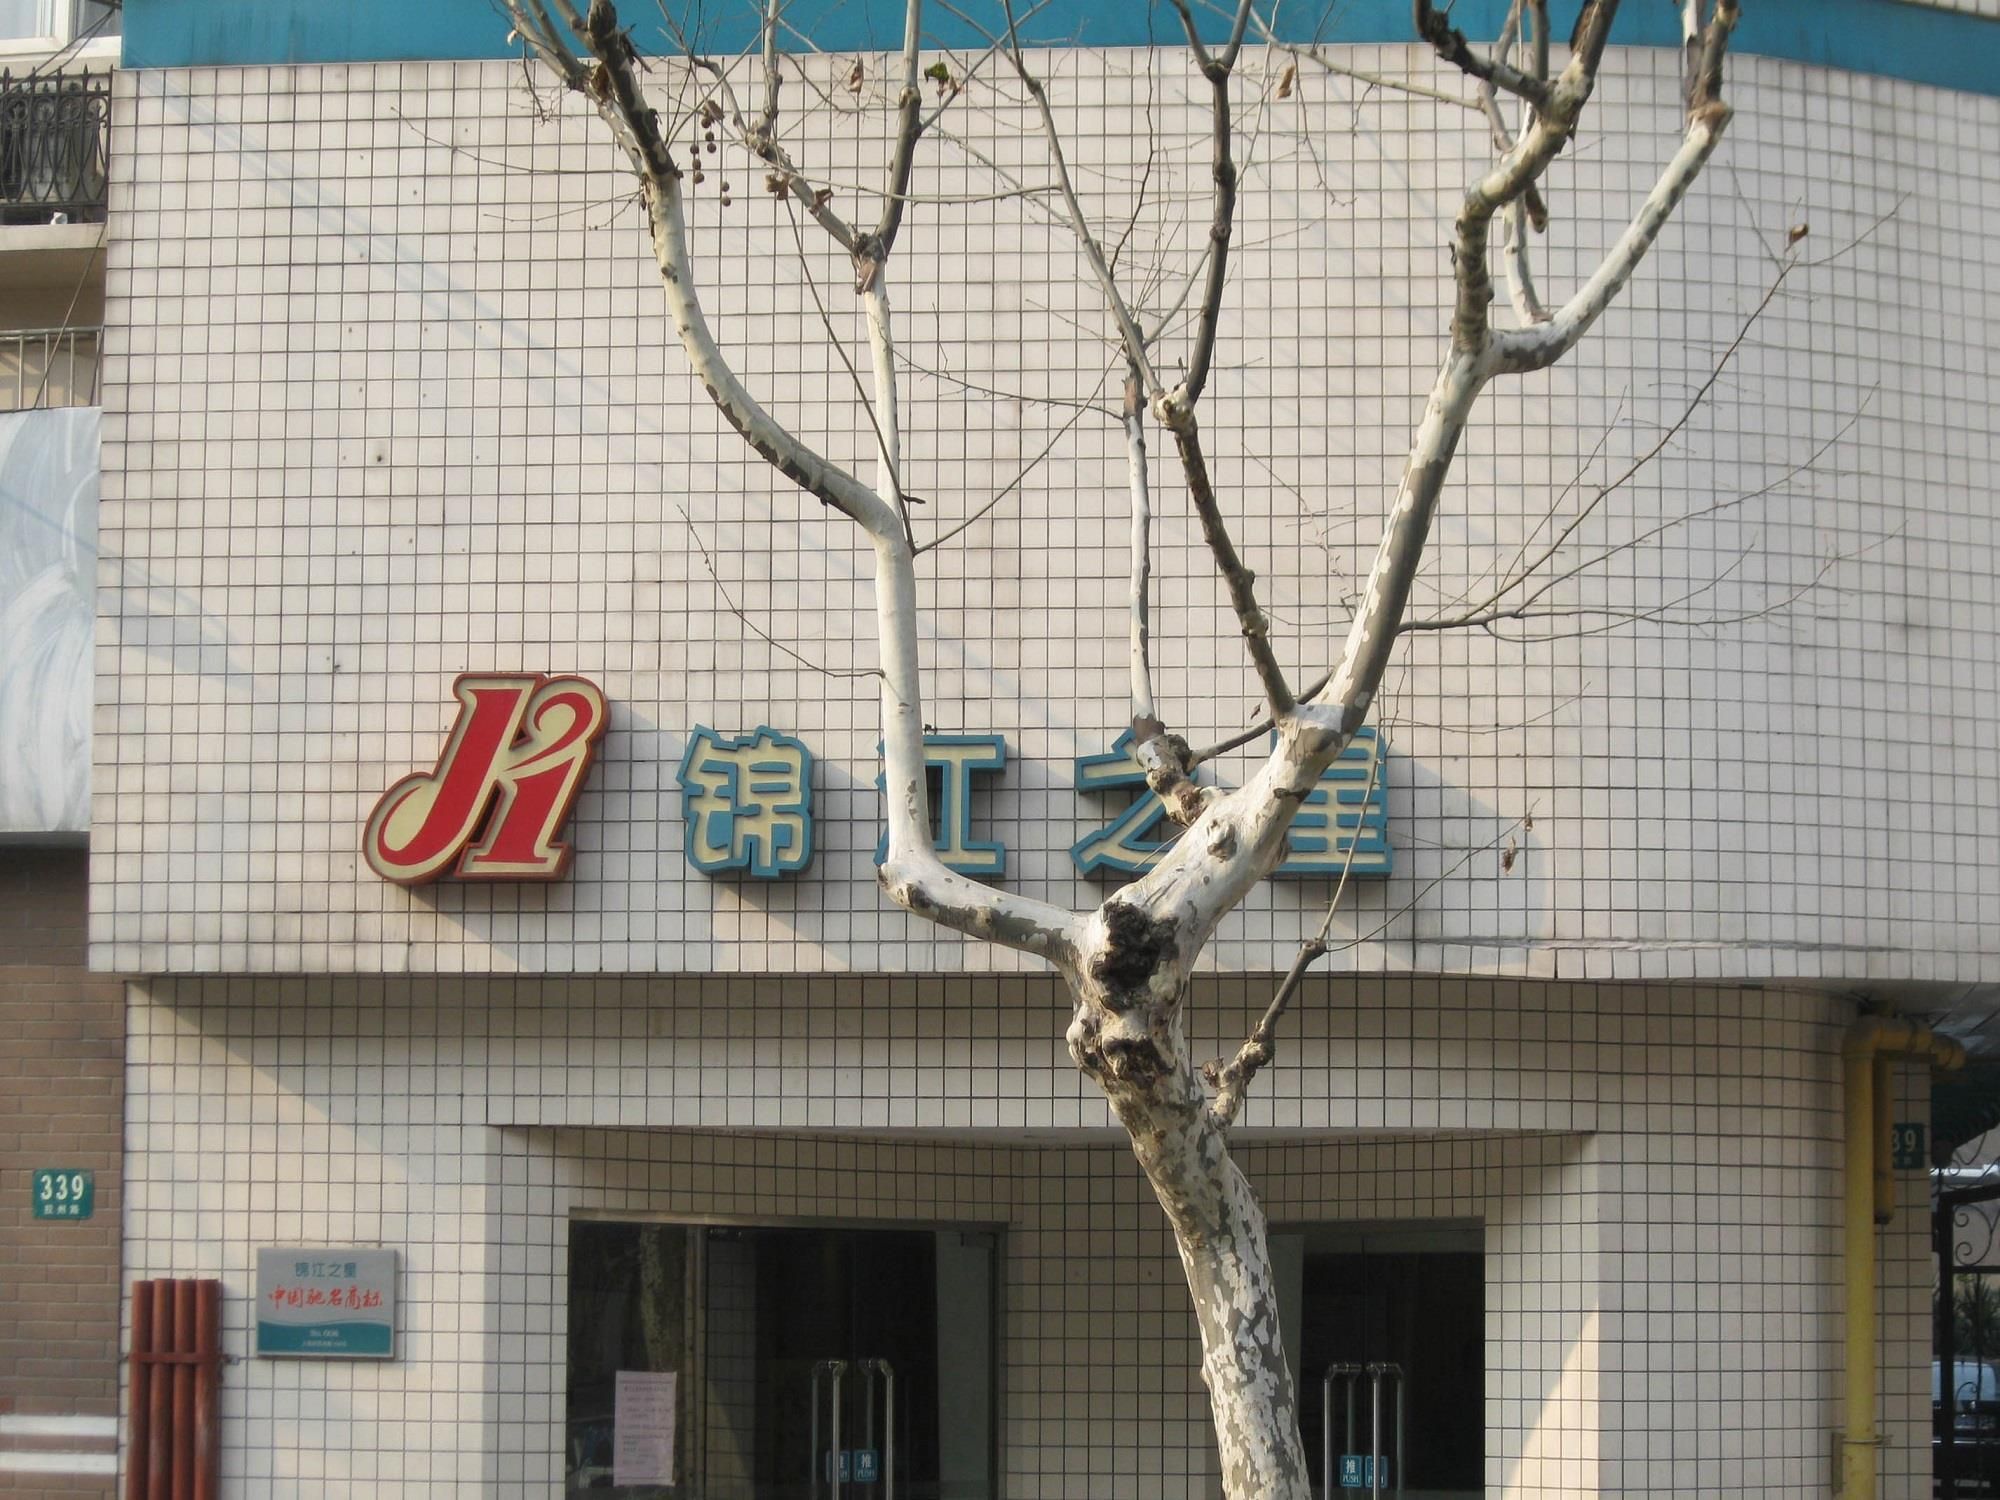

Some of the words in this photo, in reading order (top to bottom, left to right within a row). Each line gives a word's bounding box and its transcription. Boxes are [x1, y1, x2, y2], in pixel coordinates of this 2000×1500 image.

[41, 1174, 84, 1200] 339
[295, 1262, 357, 1278] 锦江之星
